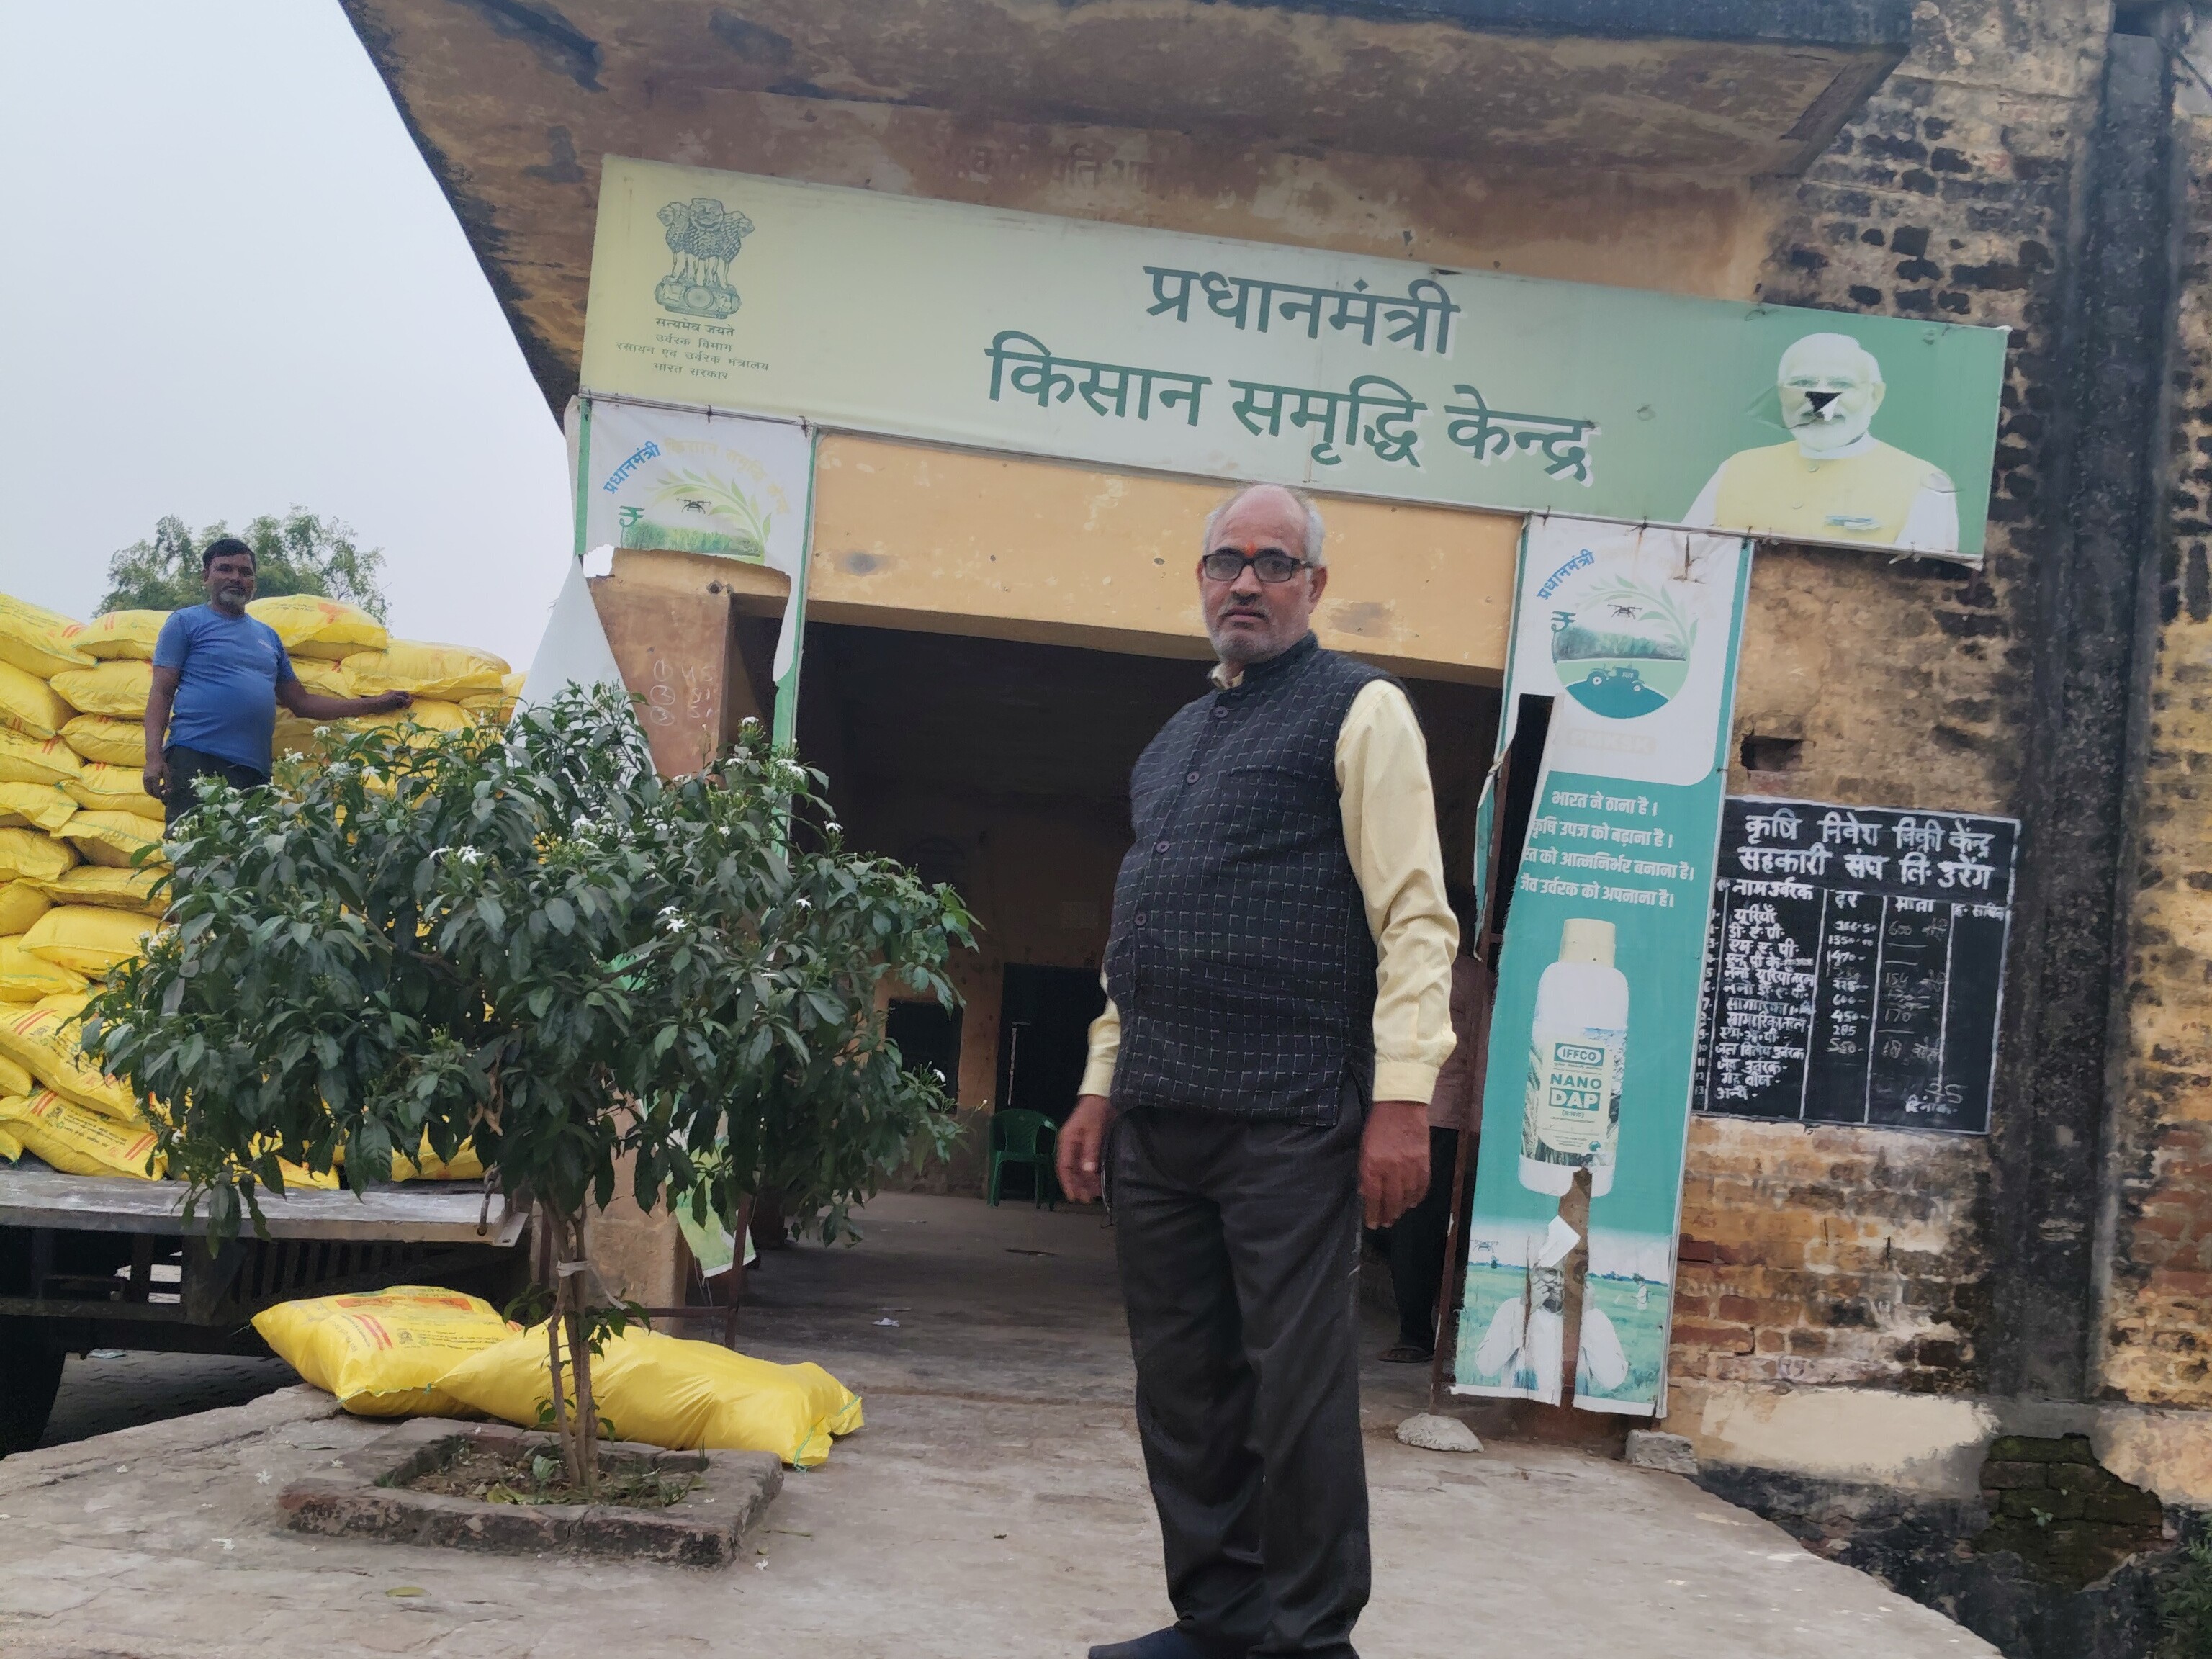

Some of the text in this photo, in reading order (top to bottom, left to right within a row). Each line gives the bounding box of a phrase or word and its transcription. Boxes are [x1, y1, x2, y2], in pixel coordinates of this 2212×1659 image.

[1143, 266, 1462, 354] प्रधानमंत्री
[656, 318, 735, 336] सत्यमेव जयते
[698, 338, 732, 352] विभाग
[653, 362, 729, 379] भारत सरकार
[984, 330, 1595, 482] किसान समृद्धि केन्द्र
[603, 441, 661, 494] प्रधानमंत्री
[1537, 548, 1596, 600] प्रधानमंत्री
[1552, 791, 1588, 809] भारत
[1590, 791, 1604, 809] ने
[1605, 796, 1636, 814] ठाना
[1638, 796, 1649, 815] है
[1560, 822, 1590, 839] उपज
[1591, 822, 1610, 840] को
[1654, 828, 1665, 848] है
[1745, 808, 1803, 844] कृषि
[1539, 846, 1559, 865] को
[1560, 851, 1632, 873] आत्मनिर्भर
[1634, 860, 1678, 878] बनाना
[1737, 842, 1833, 876] सहकारी
[1843, 848, 1889, 881] संघ
[1540, 876, 1581, 896] उर्वरक
[1581, 881, 1601, 899] को
[1601, 886, 1658, 905] अपनाना
[1563, 1048, 1596, 1061] IFFCO
[1550, 1073, 1602, 1089] NANO
[1551, 1089, 1599, 1109] DAP
